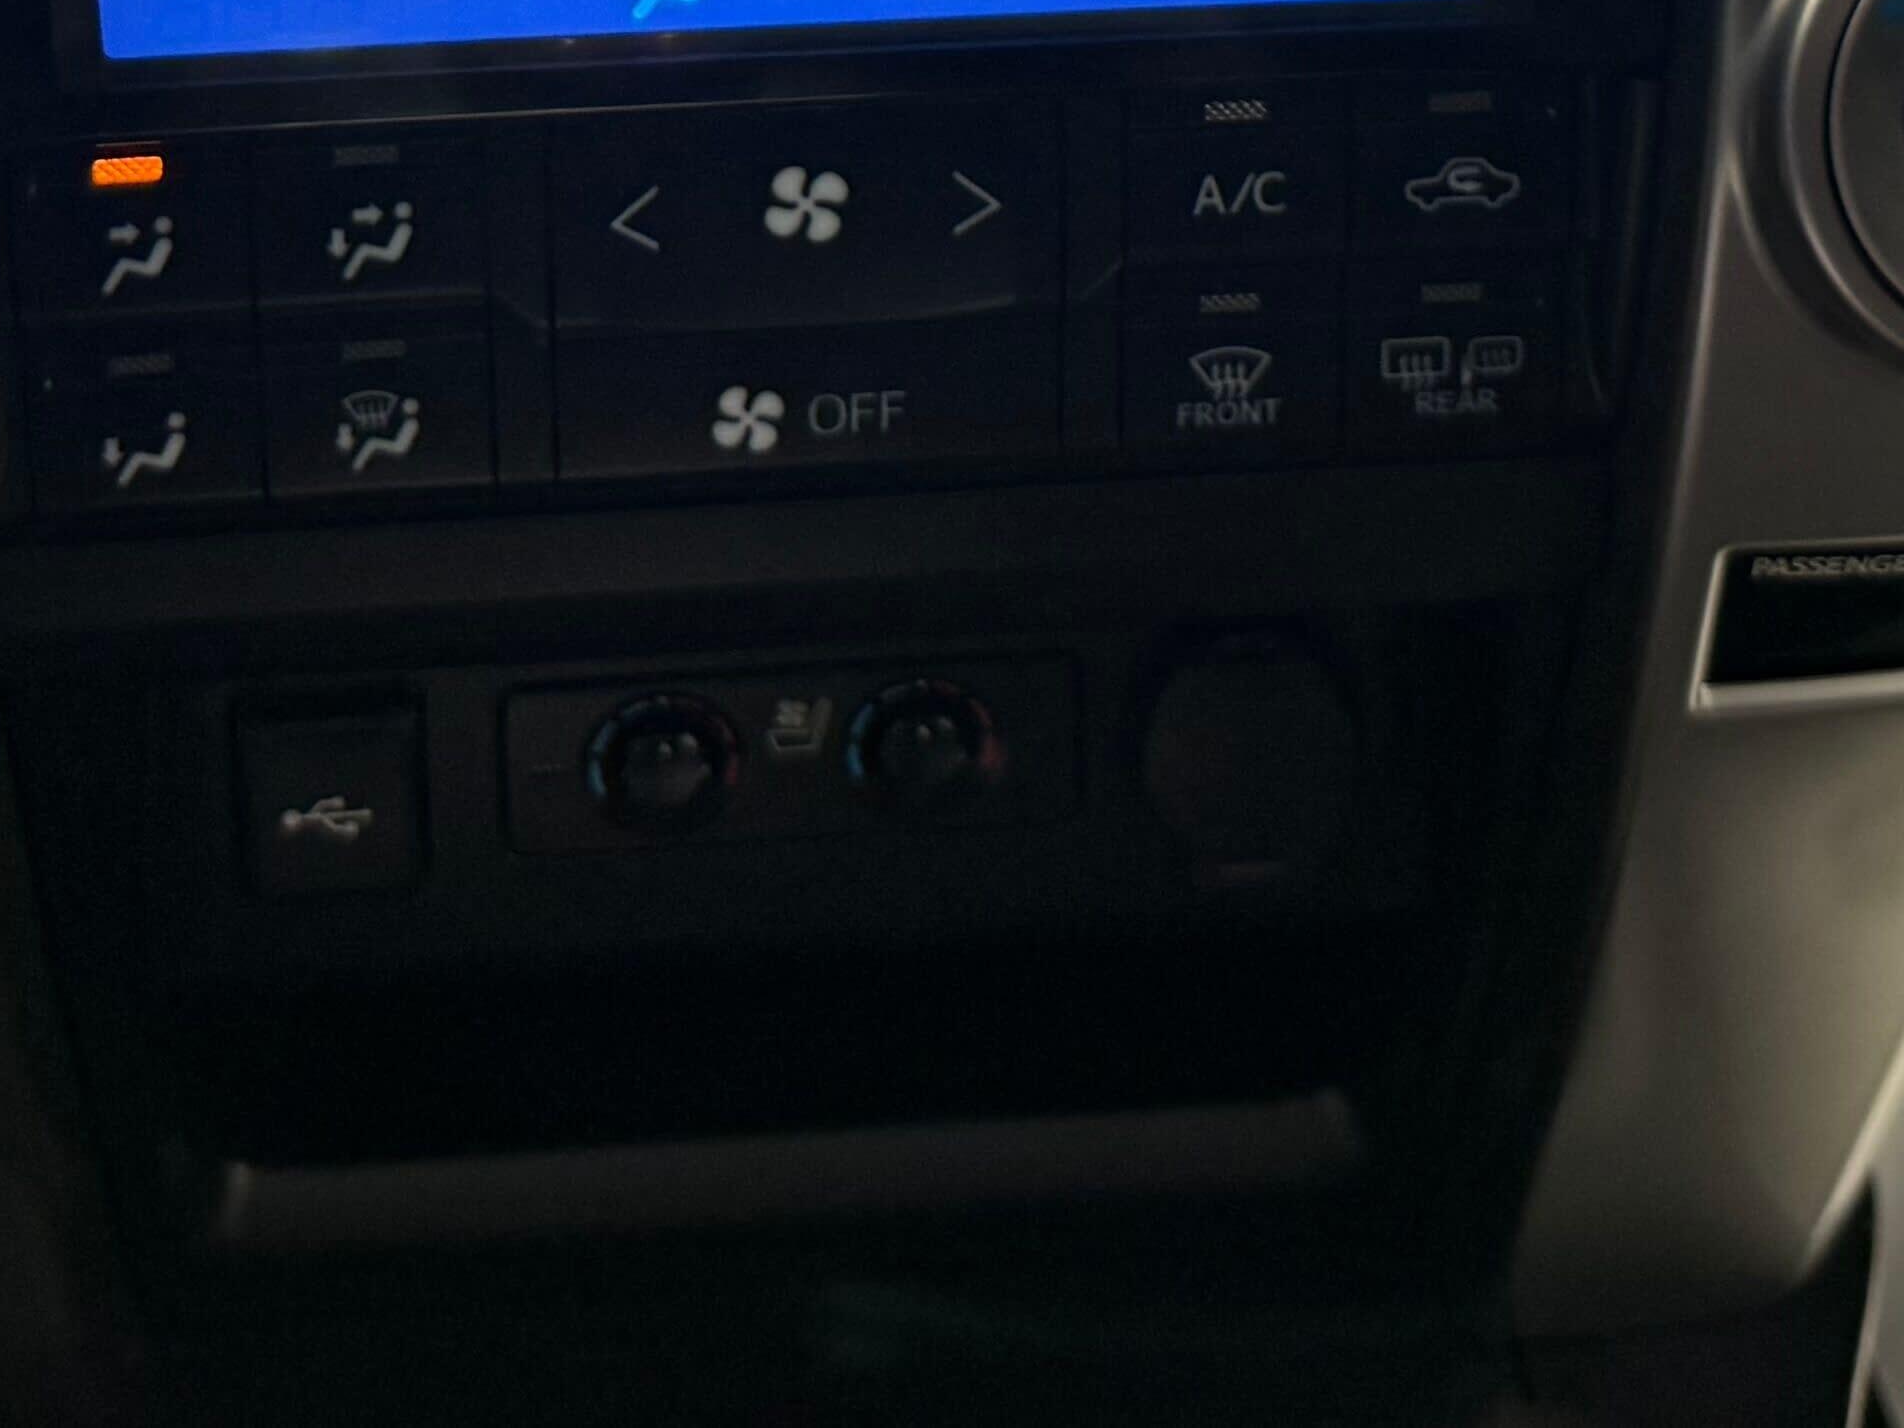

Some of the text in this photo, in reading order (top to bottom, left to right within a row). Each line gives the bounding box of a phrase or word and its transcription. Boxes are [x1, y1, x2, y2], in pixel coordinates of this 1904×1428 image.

[1192, 169, 1289, 217] A/C
[807, 389, 907, 434] OFF
[1176, 396, 1283, 428] FRONT
